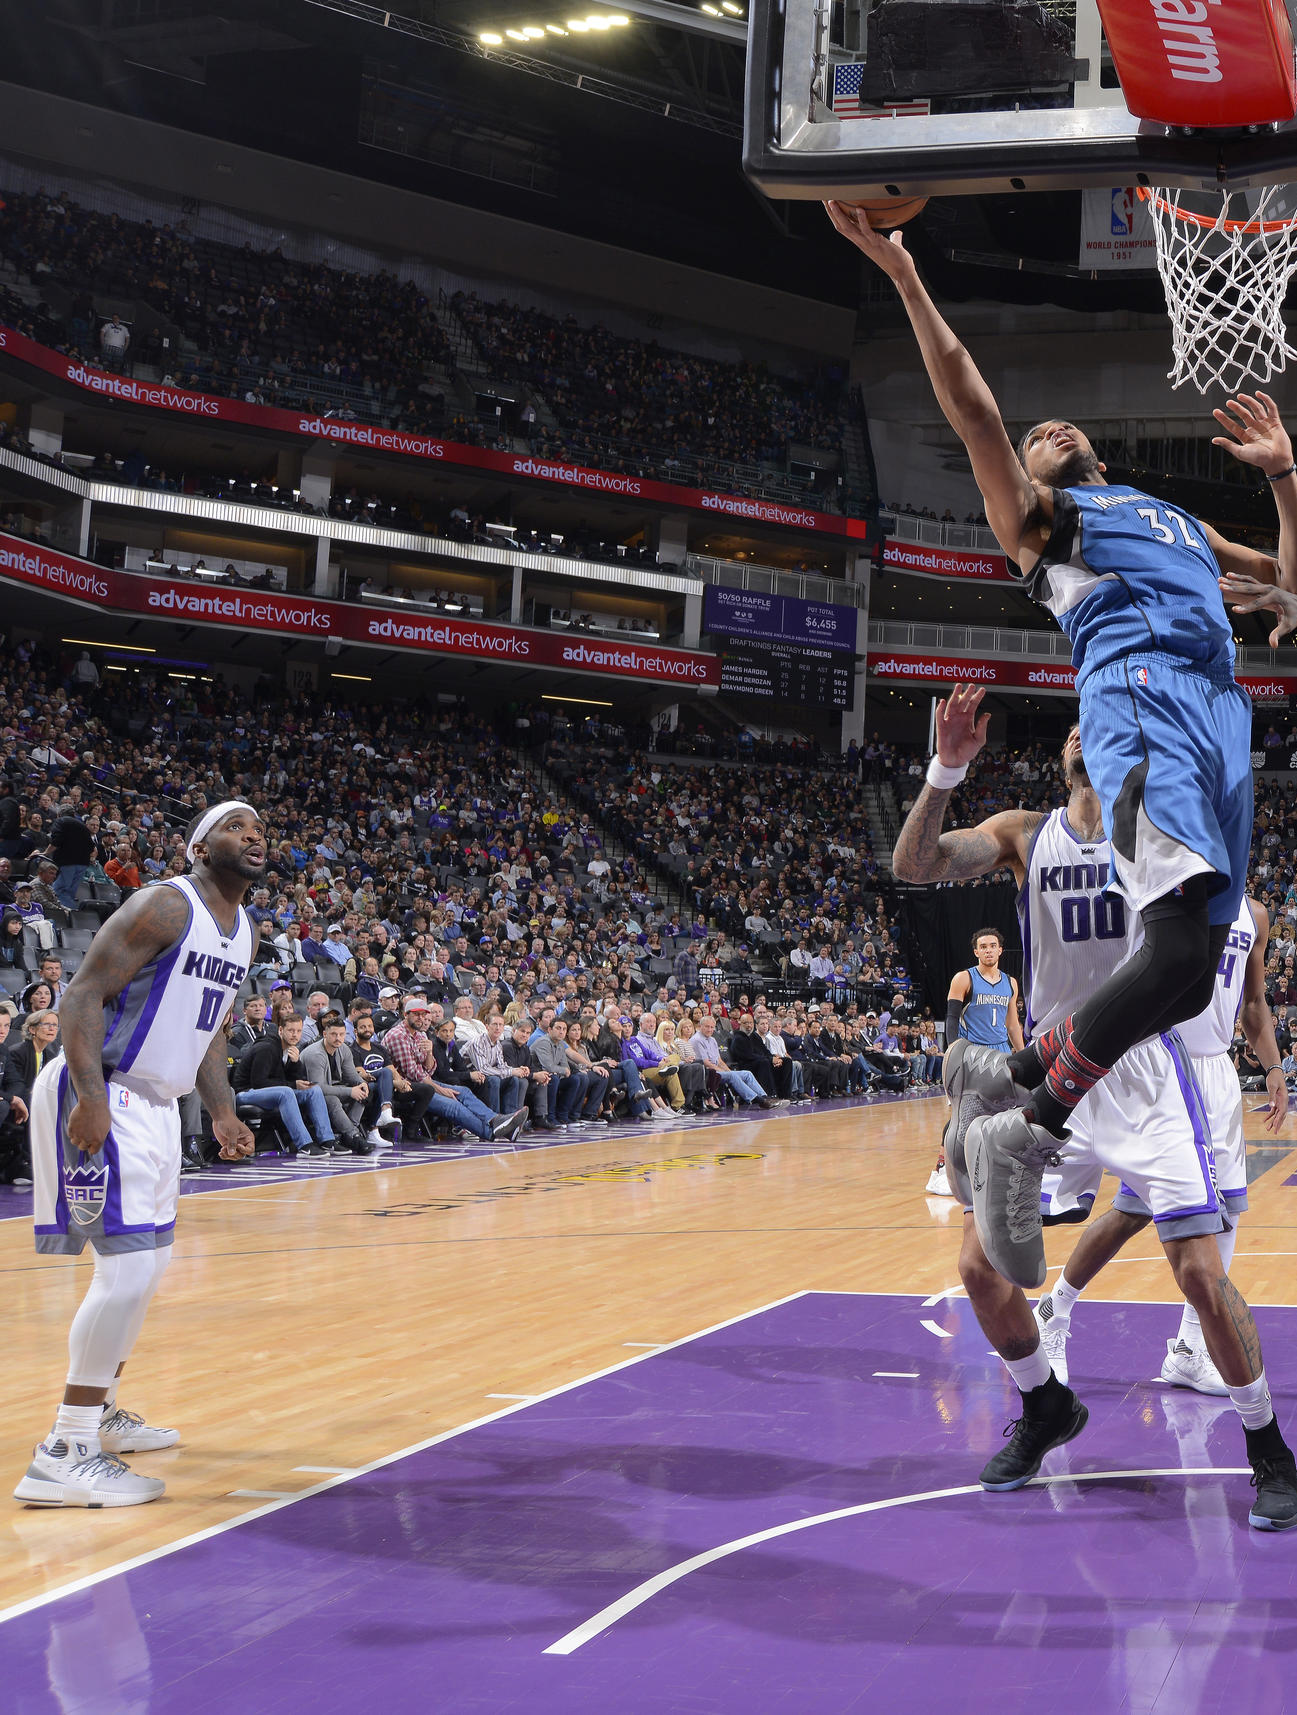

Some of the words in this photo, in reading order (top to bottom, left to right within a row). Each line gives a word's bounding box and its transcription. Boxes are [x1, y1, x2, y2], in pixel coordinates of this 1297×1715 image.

[1154, 0, 1223, 83] arm
[1086, 241, 1112, 250] WORLD
[1114, 240, 1157, 250] CHAMPIONS
[1111, 252, 1132, 260] 1951
[67, 364, 219, 415] advantelnetworks
[299, 418, 444, 457] advantelnetworks
[513, 459, 641, 494] advantelnetworks
[701, 495, 815, 527] advantelnetworks
[1135, 507, 1201, 549] 32
[883, 548, 993, 574] advantelnetworks
[148, 589, 331, 628] advantelnetworks
[718, 593, 741, 602] 50/50
[742, 596, 771, 607] RAFFLE
[368, 619, 529, 655] advantelnetworks
[805, 616, 837, 630] $6,455
[563, 645, 707, 678] advantelnetworks
[730, 638, 771, 650] DRAFTKINGS
[773, 643, 801, 654] FANTASY
[803, 649, 832, 658] LEADERS
[722, 674, 743, 682] DEMAR
[744, 677, 771, 686] DEROZAN
[744, 668, 767, 676] HARDEN
[878, 660, 996, 680] advantelnetworks
[721, 684, 753, 693] DRAYMOND
[1040, 863, 1109, 893] KIN
[1061, 895, 1126, 942] 00
[182, 951, 247, 987] KINGS
[196, 986, 226, 1032] 10
[992, 1008, 997, 1027] 1
[66, 1187, 104, 1202] SAC
